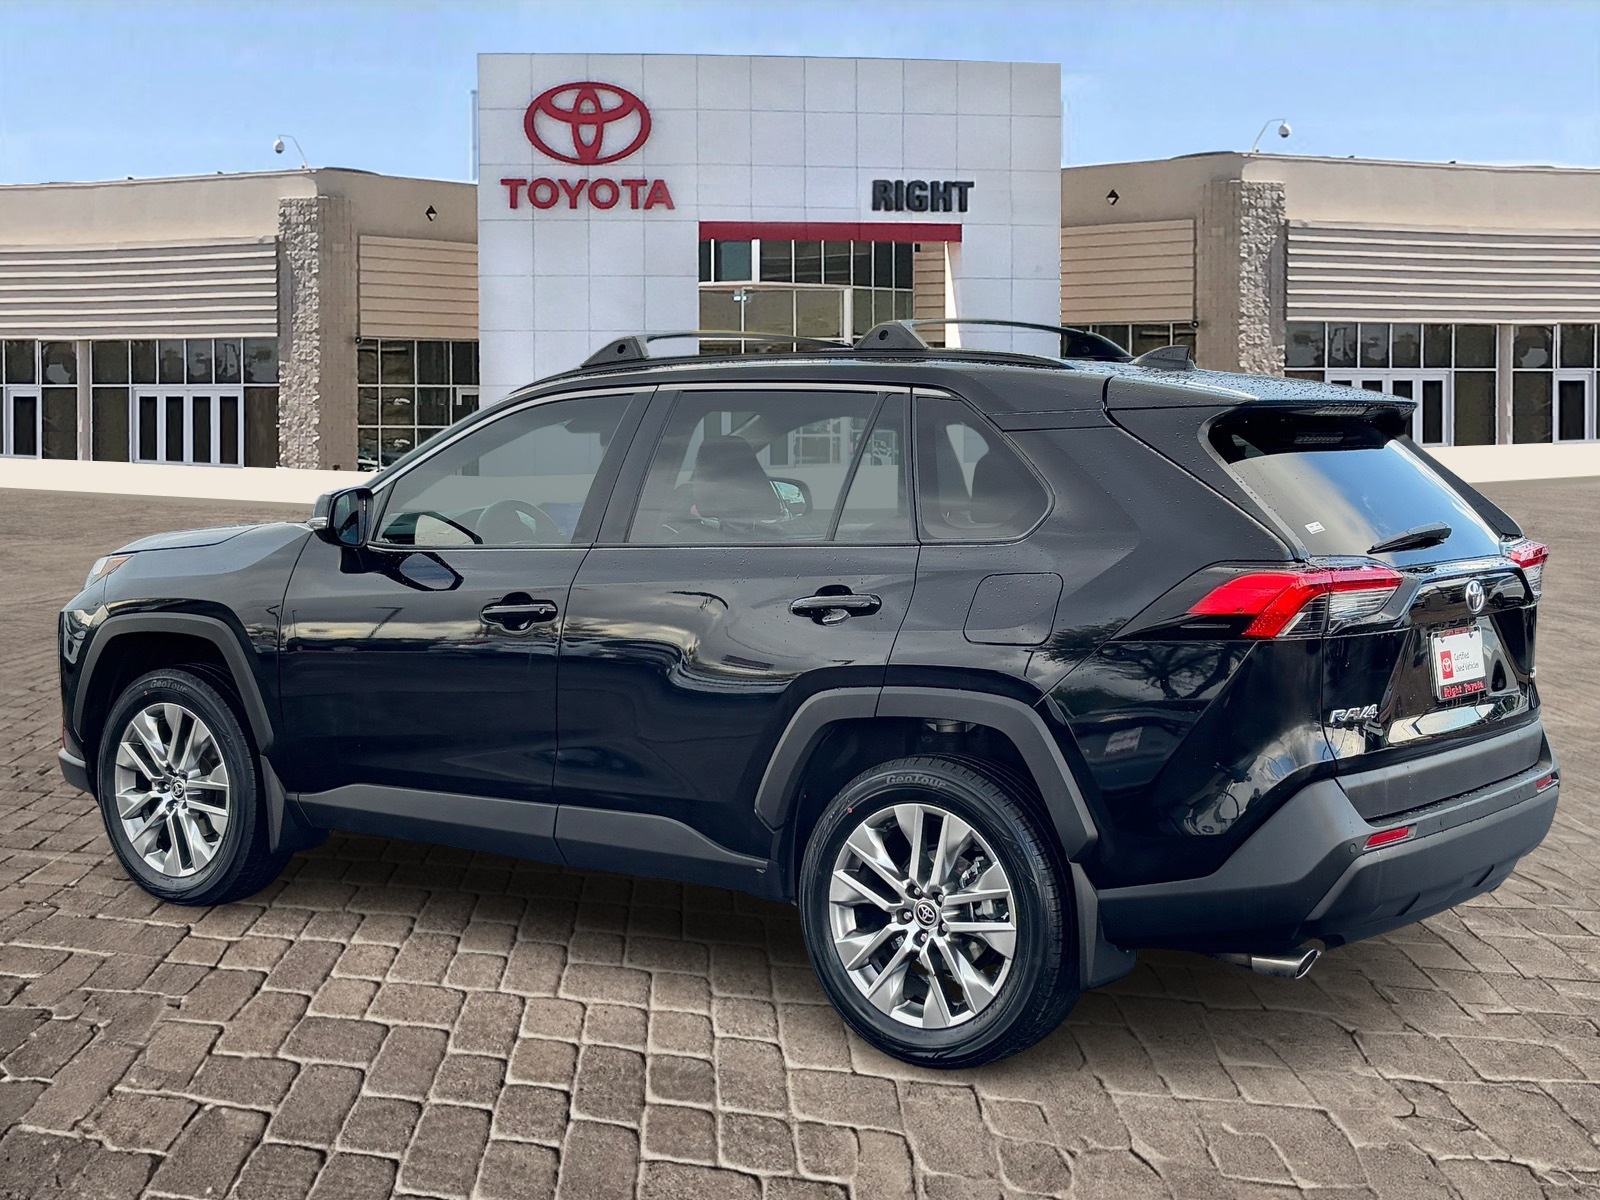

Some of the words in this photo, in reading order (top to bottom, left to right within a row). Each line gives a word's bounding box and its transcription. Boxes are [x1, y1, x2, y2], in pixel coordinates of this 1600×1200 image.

[500, 178, 675, 210] TOYOTA
[871, 180, 975, 213] RIGHT
[150, 680, 187, 692] GeoTour
[1443, 685, 1462, 697] Right
[1329, 703, 1379, 723] RAV4
